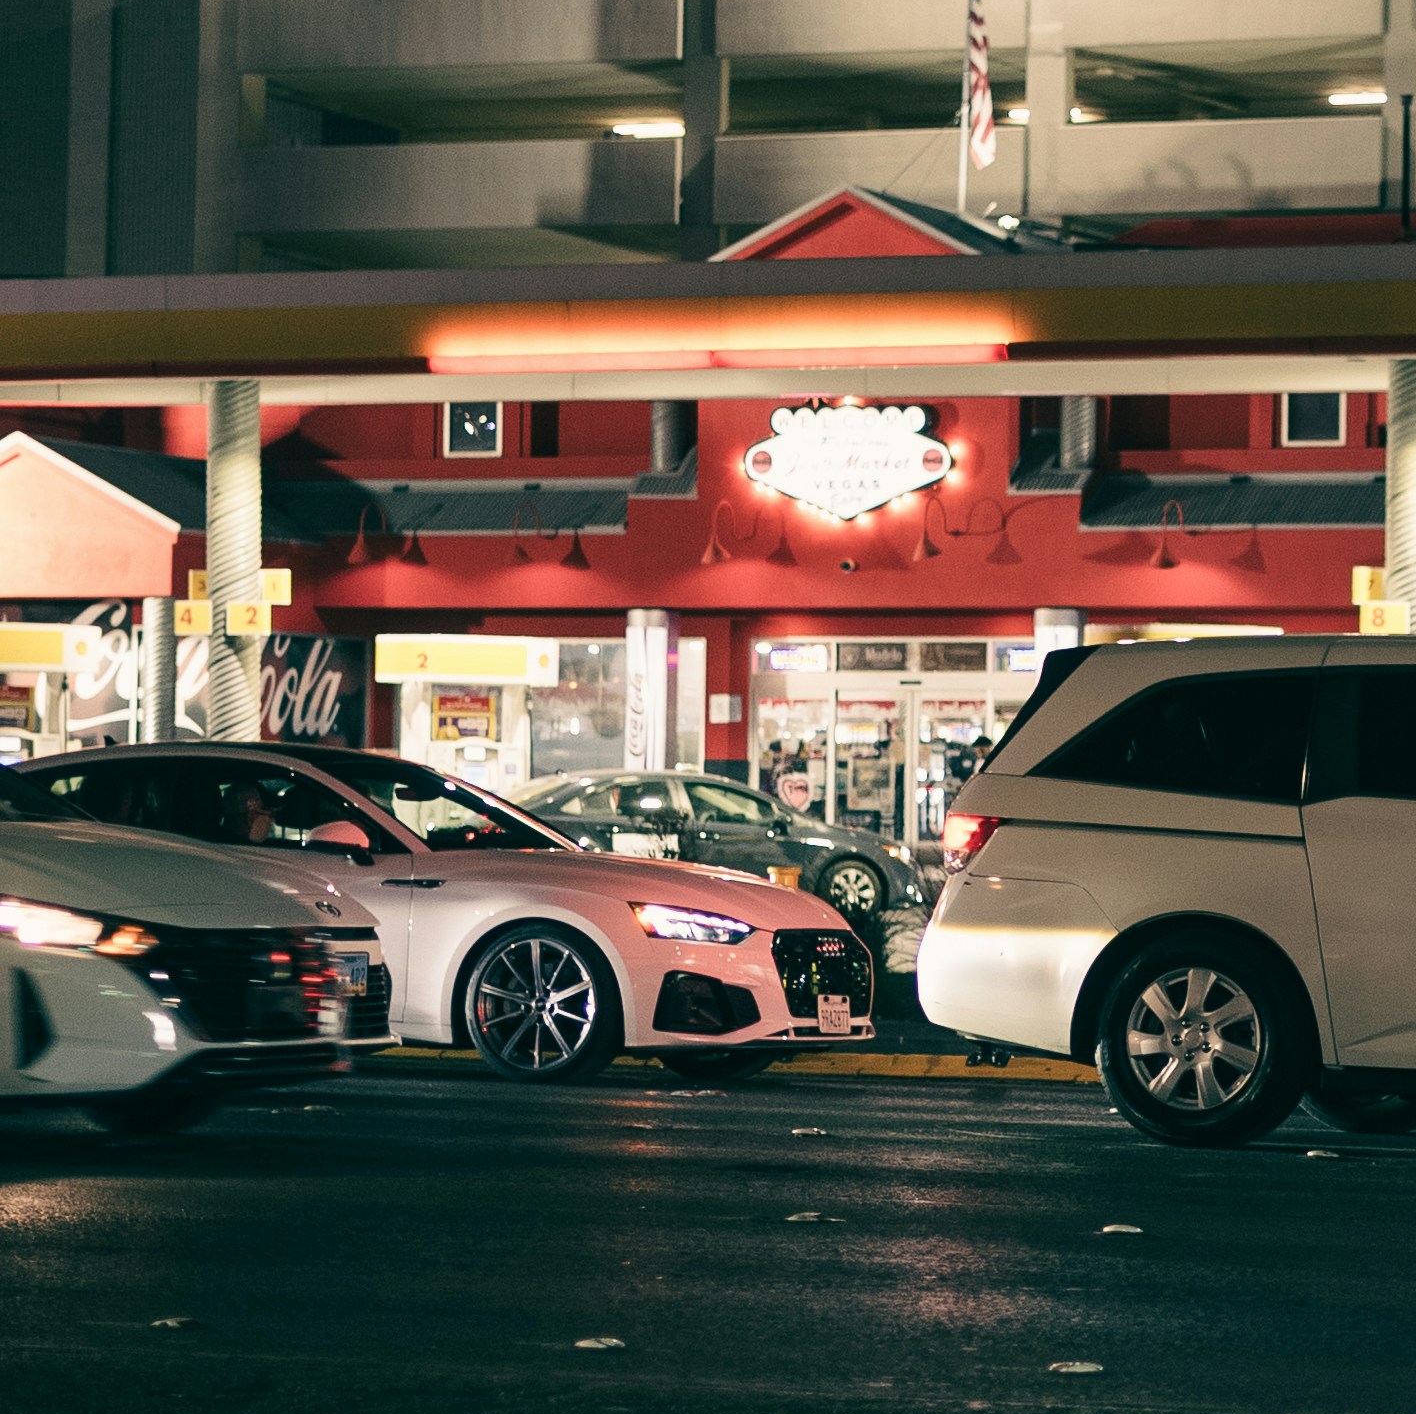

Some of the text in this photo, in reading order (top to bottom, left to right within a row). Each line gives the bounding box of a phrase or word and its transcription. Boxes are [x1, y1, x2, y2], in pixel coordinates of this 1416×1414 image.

[777, 413, 916, 429] WELCOME
[841, 452, 911, 471] Market
[813, 479, 881, 490] VEGAS
[179, 607, 194, 626] 4
[245, 607, 258, 626] 2
[1371, 607, 1386, 628] 8
[416, 652, 429, 669] 2
